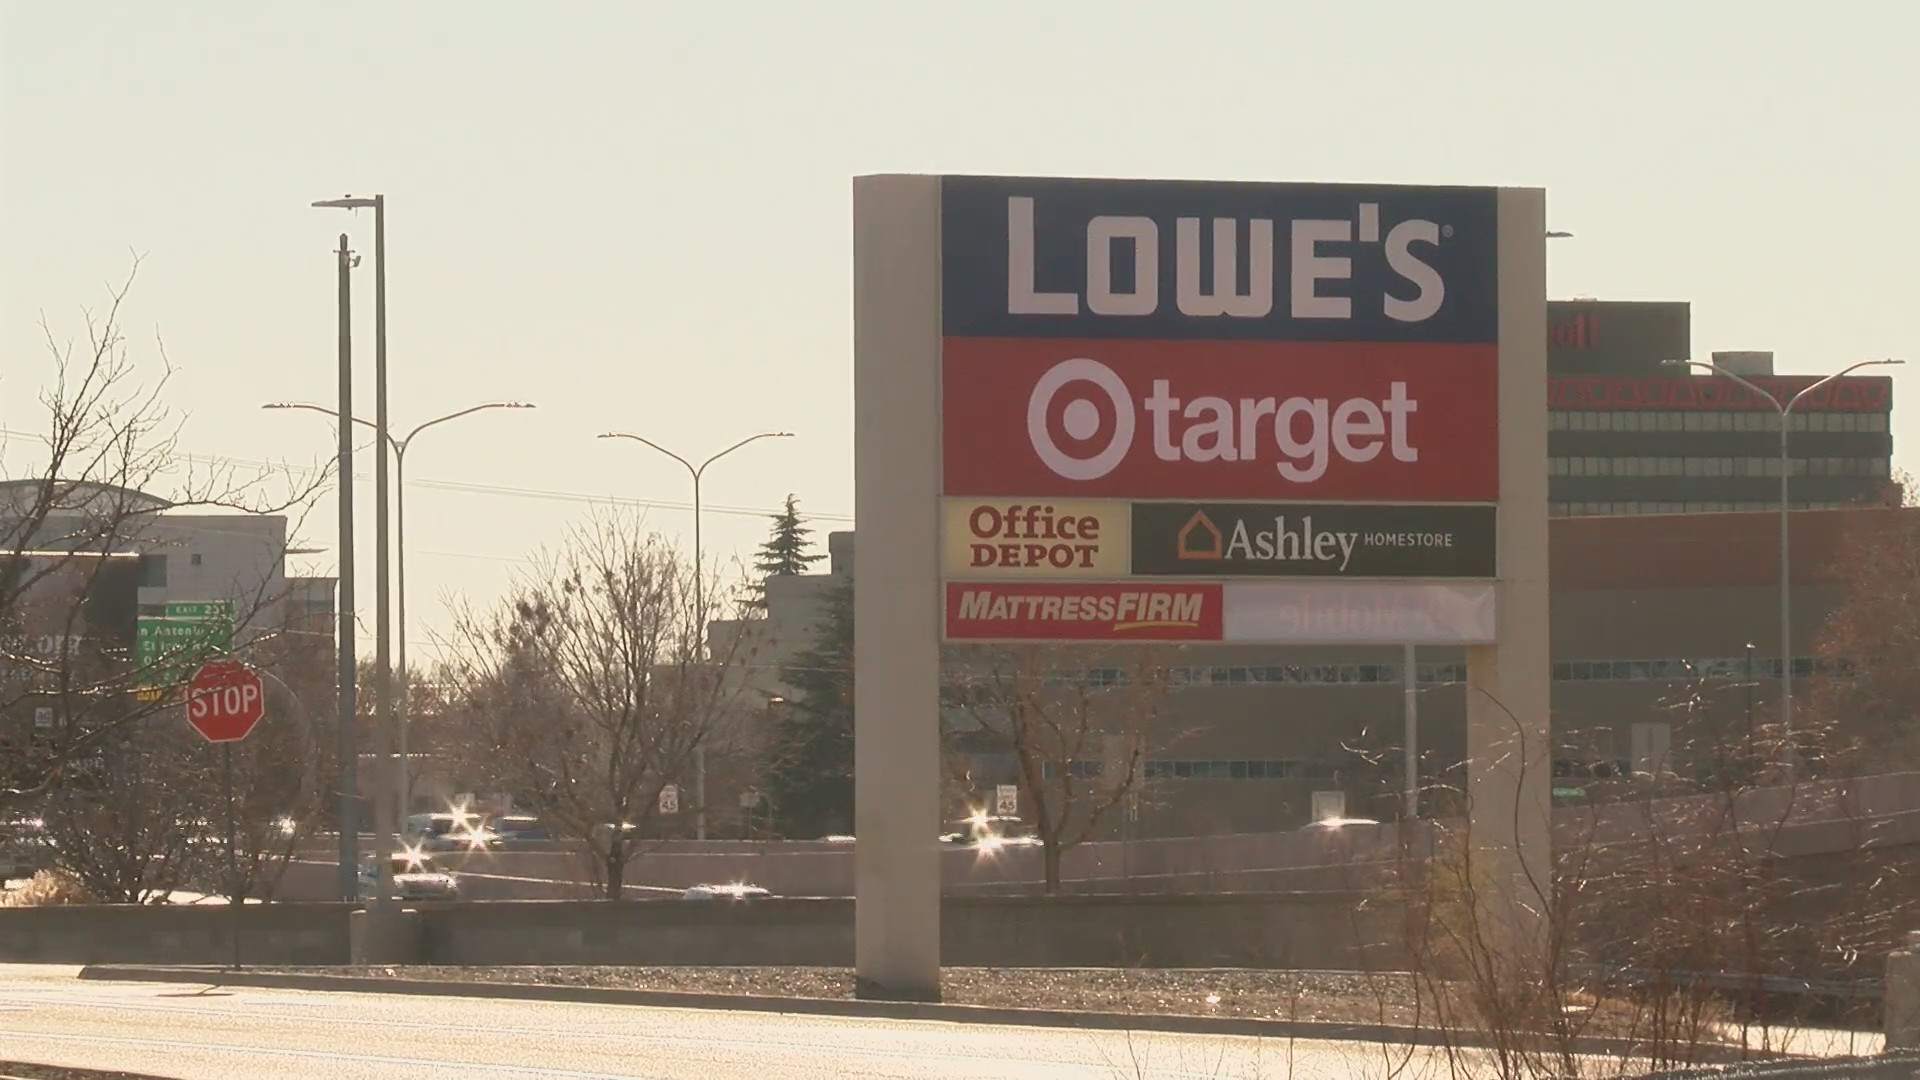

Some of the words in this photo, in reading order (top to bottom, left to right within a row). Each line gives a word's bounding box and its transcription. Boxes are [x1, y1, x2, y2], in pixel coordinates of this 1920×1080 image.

[1008, 196, 1445, 322] LOWE'S
[1144, 379, 1418, 482] target
[969, 505, 1100, 539] Office
[970, 543, 1099, 568] DEPOT
[1224, 515, 1358, 572] Ashley
[1364, 532, 1453, 547] HOMESTORE
[175, 606, 197, 614] EXIT
[191, 684, 258, 717] STOP
[1000, 799, 1015, 811] 45
